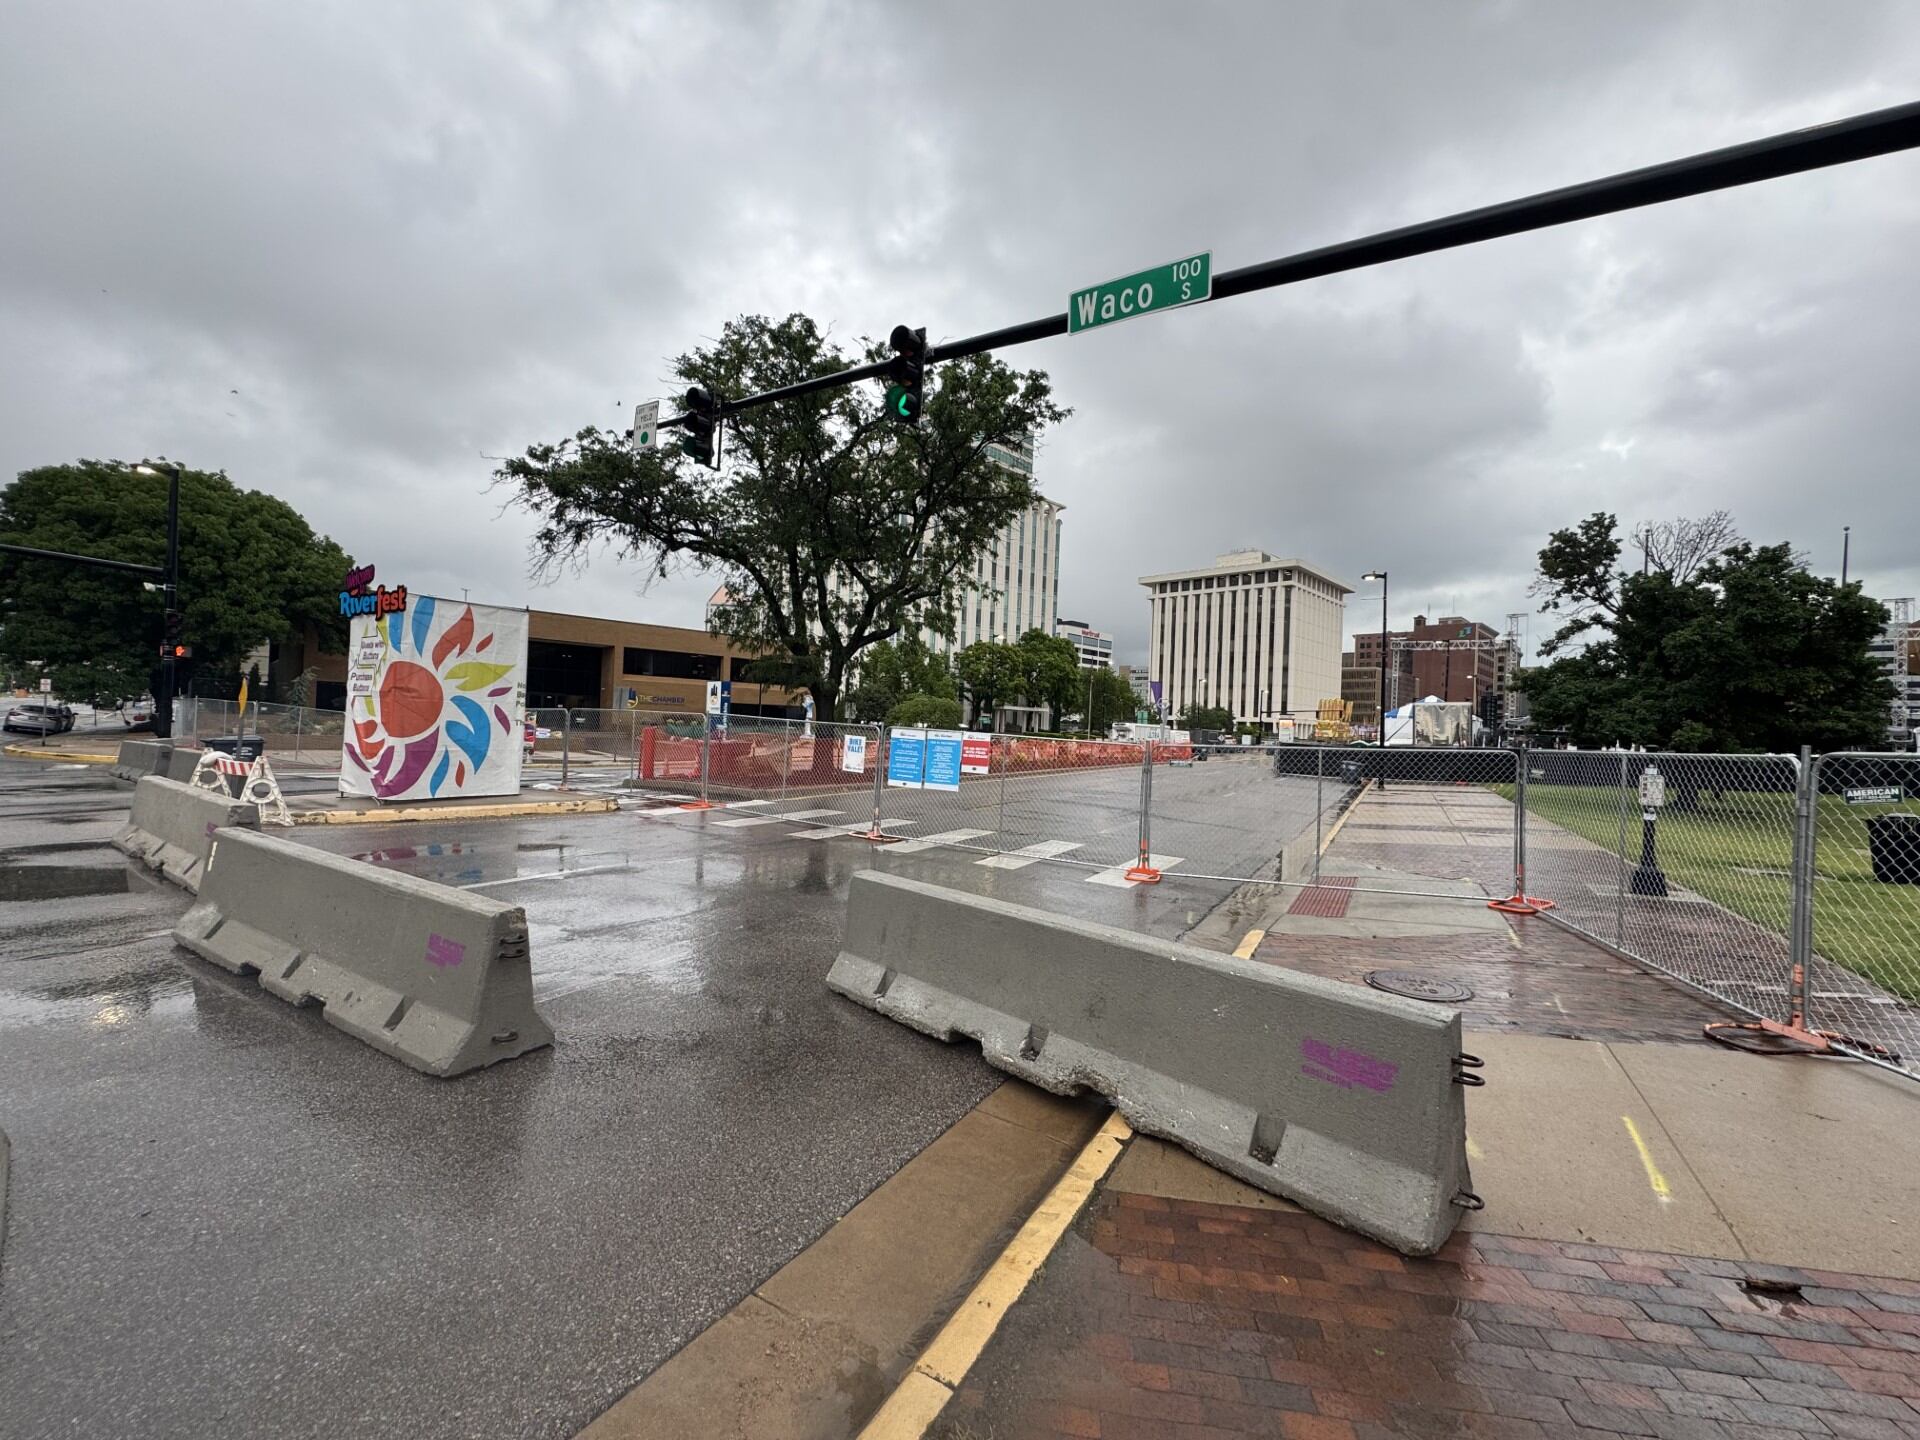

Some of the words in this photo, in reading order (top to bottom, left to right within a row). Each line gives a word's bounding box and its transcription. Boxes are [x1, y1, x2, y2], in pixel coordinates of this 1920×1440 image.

[1172, 258, 1202, 282] 100
[1181, 282, 1191, 300] S
[1077, 283, 1153, 326] Waco
[339, 585, 407, 619] Riverfest
[847, 745, 863, 753] VALET
[849, 738, 862, 746] BIKE
[1847, 788, 1899, 796] AMERICAN
